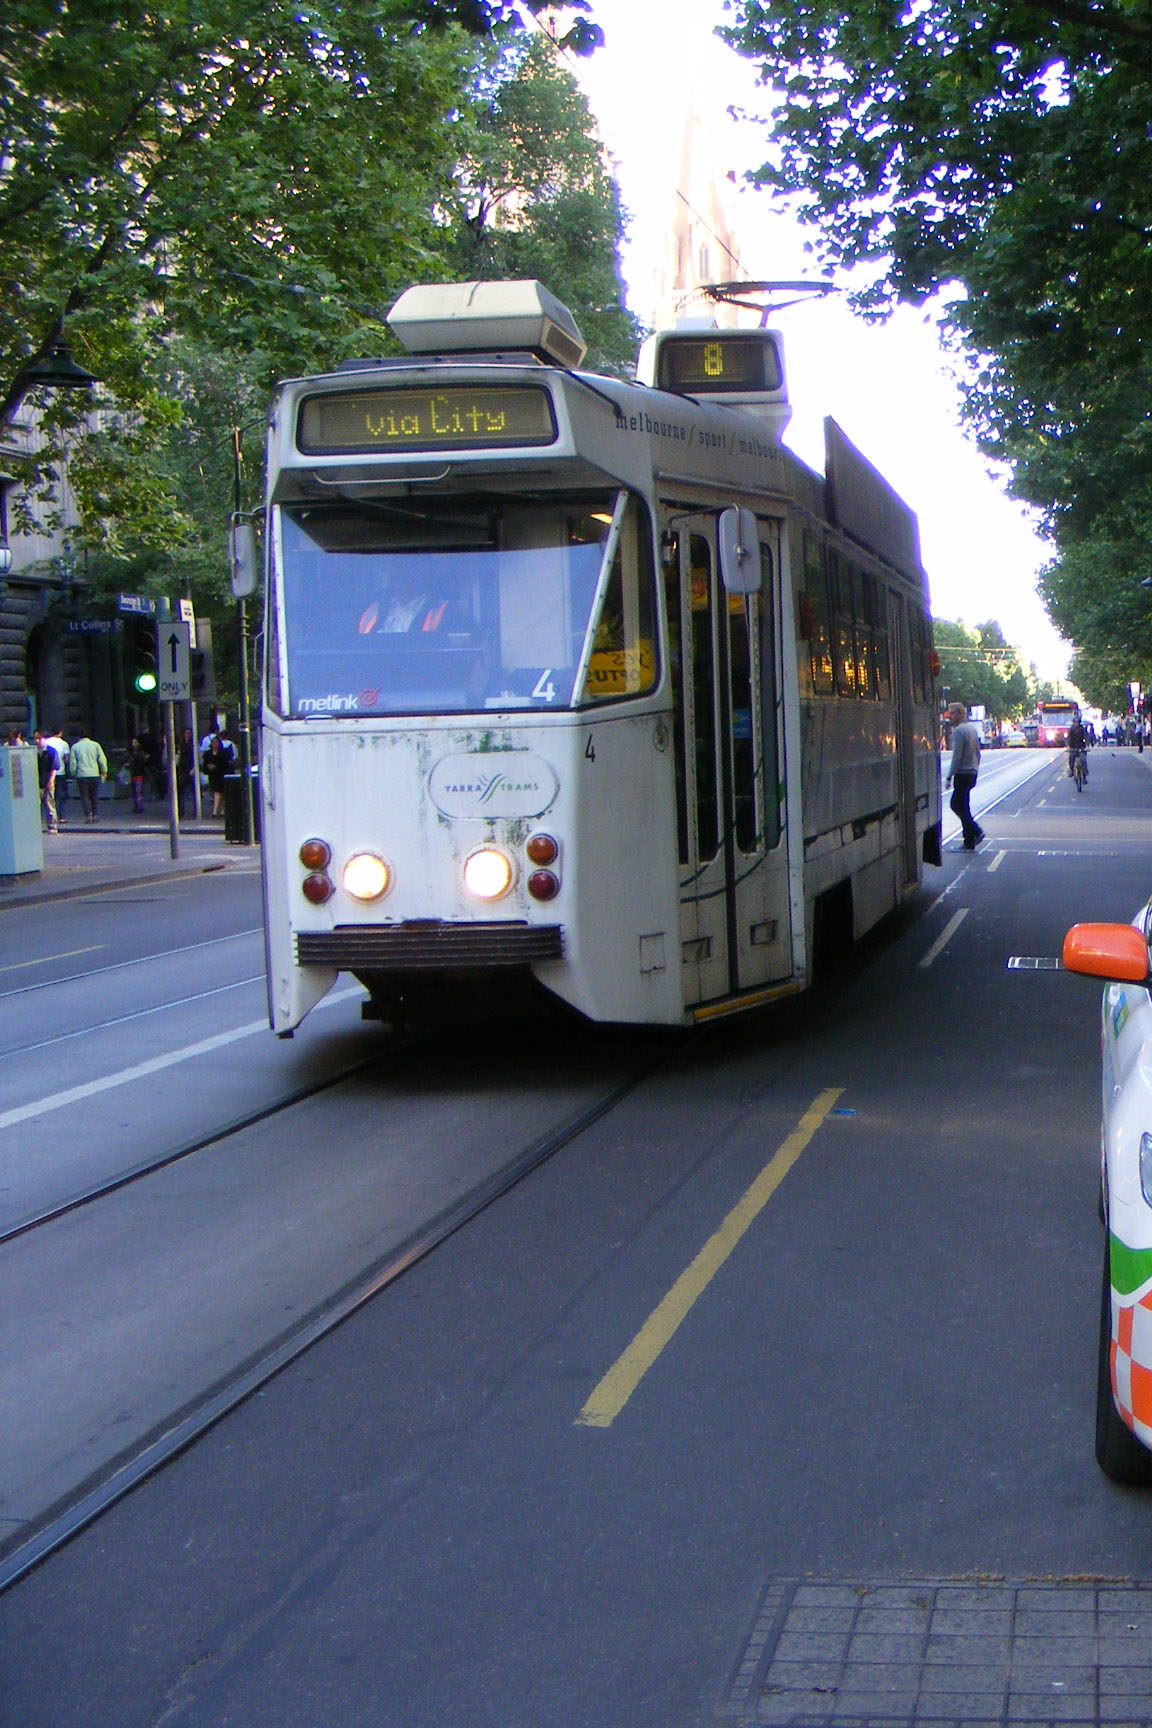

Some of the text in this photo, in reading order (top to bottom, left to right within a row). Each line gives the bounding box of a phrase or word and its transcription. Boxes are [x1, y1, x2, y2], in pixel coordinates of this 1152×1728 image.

[704, 342, 724, 376] 8
[366, 395, 506, 436] via City
[615, 411, 687, 441] melbourne
[699, 431, 727, 449] sport
[160, 681, 188, 691] ONLY
[531, 669, 556, 702] 4
[297, 690, 359, 713] metlink
[584, 734, 597, 763] 4
[445, 782, 539, 793] YARRA TRAMS
